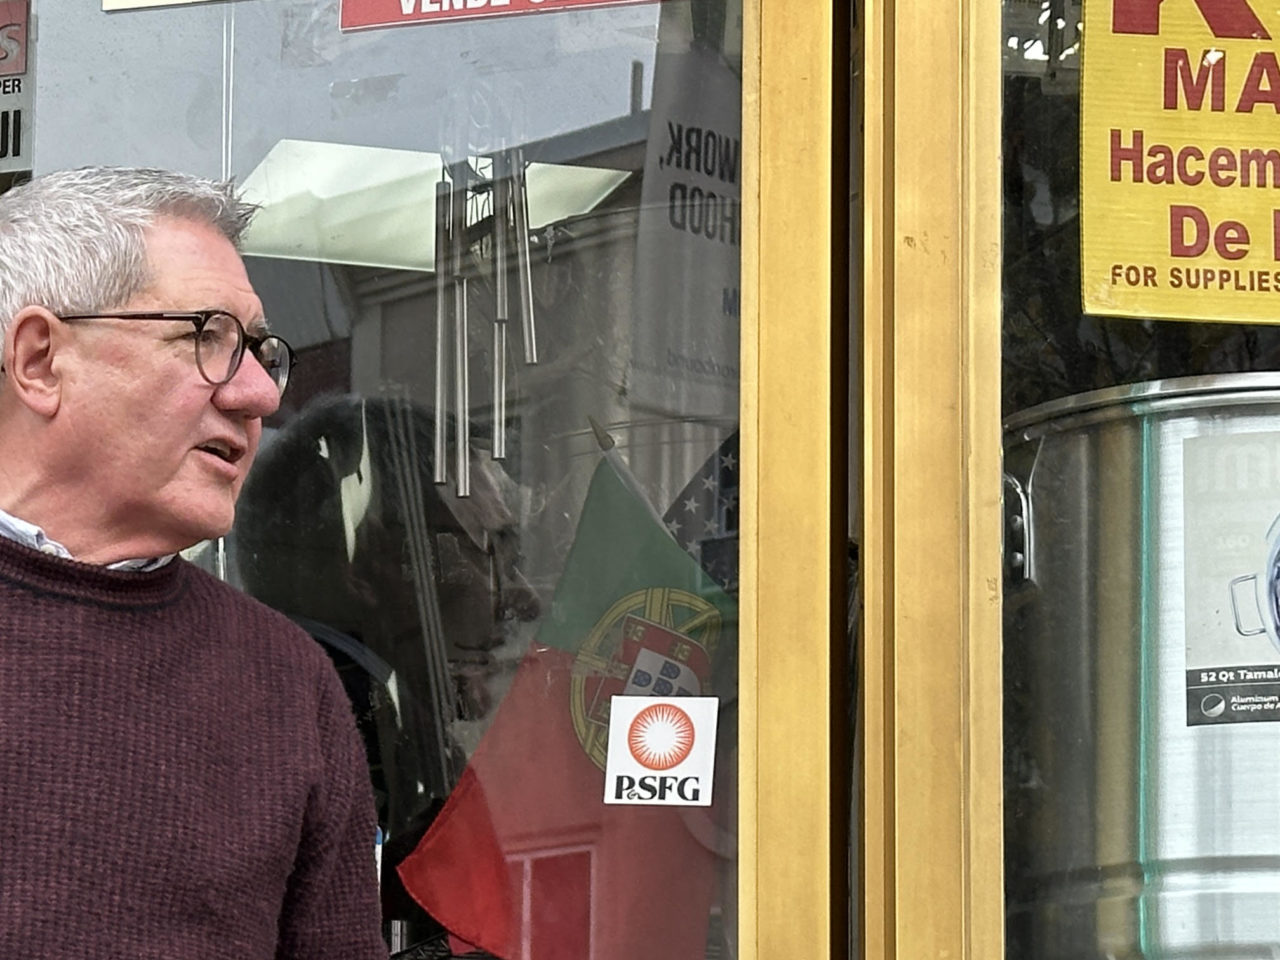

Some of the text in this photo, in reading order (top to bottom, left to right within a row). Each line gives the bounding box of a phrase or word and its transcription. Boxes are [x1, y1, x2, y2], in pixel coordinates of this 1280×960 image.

[1170, 204, 1251, 261] De
[1111, 264, 1158, 287] FOR
[1200, 671, 1217, 682] 52
[1218, 671, 1235, 683] Qt
